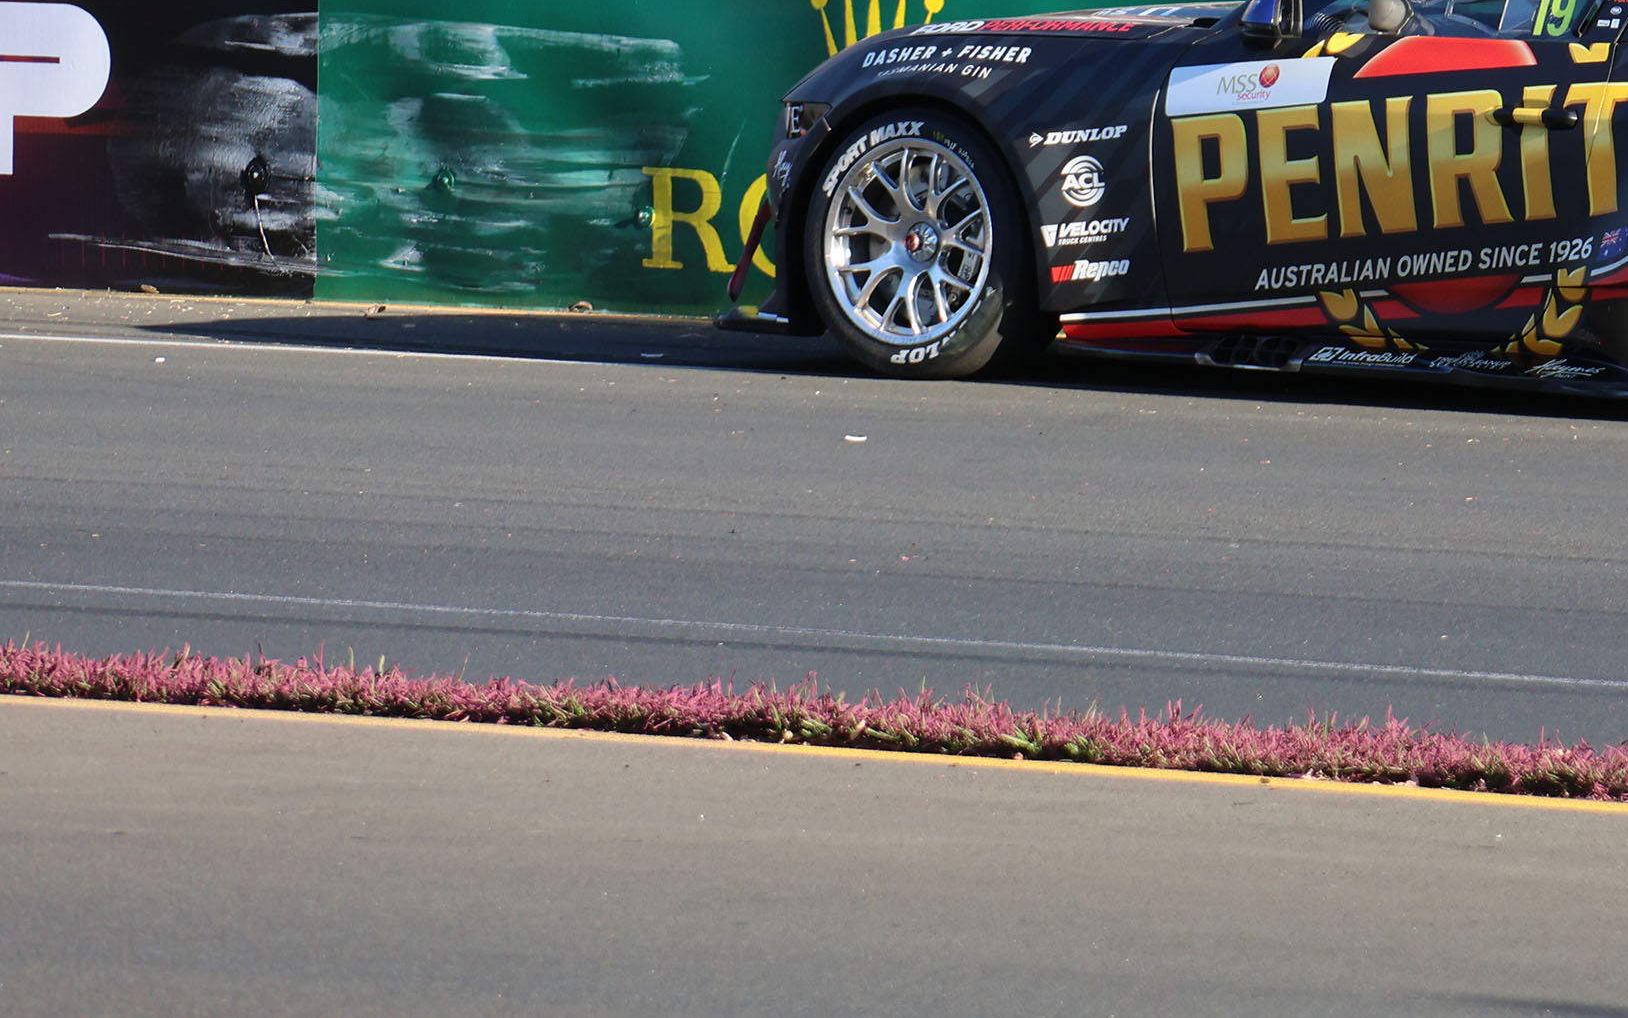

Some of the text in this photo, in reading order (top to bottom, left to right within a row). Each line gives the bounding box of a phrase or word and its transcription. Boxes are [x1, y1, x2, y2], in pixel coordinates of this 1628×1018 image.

[910, 19, 1136, 36] FORD PERFORMANCE
[862, 45, 938, 68] DASHER
[957, 44, 1033, 63] FISHER
[875, 62, 993, 80] TASMANIAN GIN
[1216, 73, 1258, 95] MSS
[1236, 89, 1272, 101] security
[1043, 124, 1128, 146] DUNLOP
[822, 134, 869, 198] SPORT
[869, 121, 926, 145] MAXX
[1061, 172, 1106, 191] ACL
[1058, 217, 1130, 238] VELOCITY
[1057, 235, 1108, 246] TRUCK CENTRES
[1071, 259, 1131, 282] Repco
[1254, 236, 1594, 291] AUSTRALIAN OWNED SINCE 1926
[1337, 350, 1418, 364] InfraBuild
